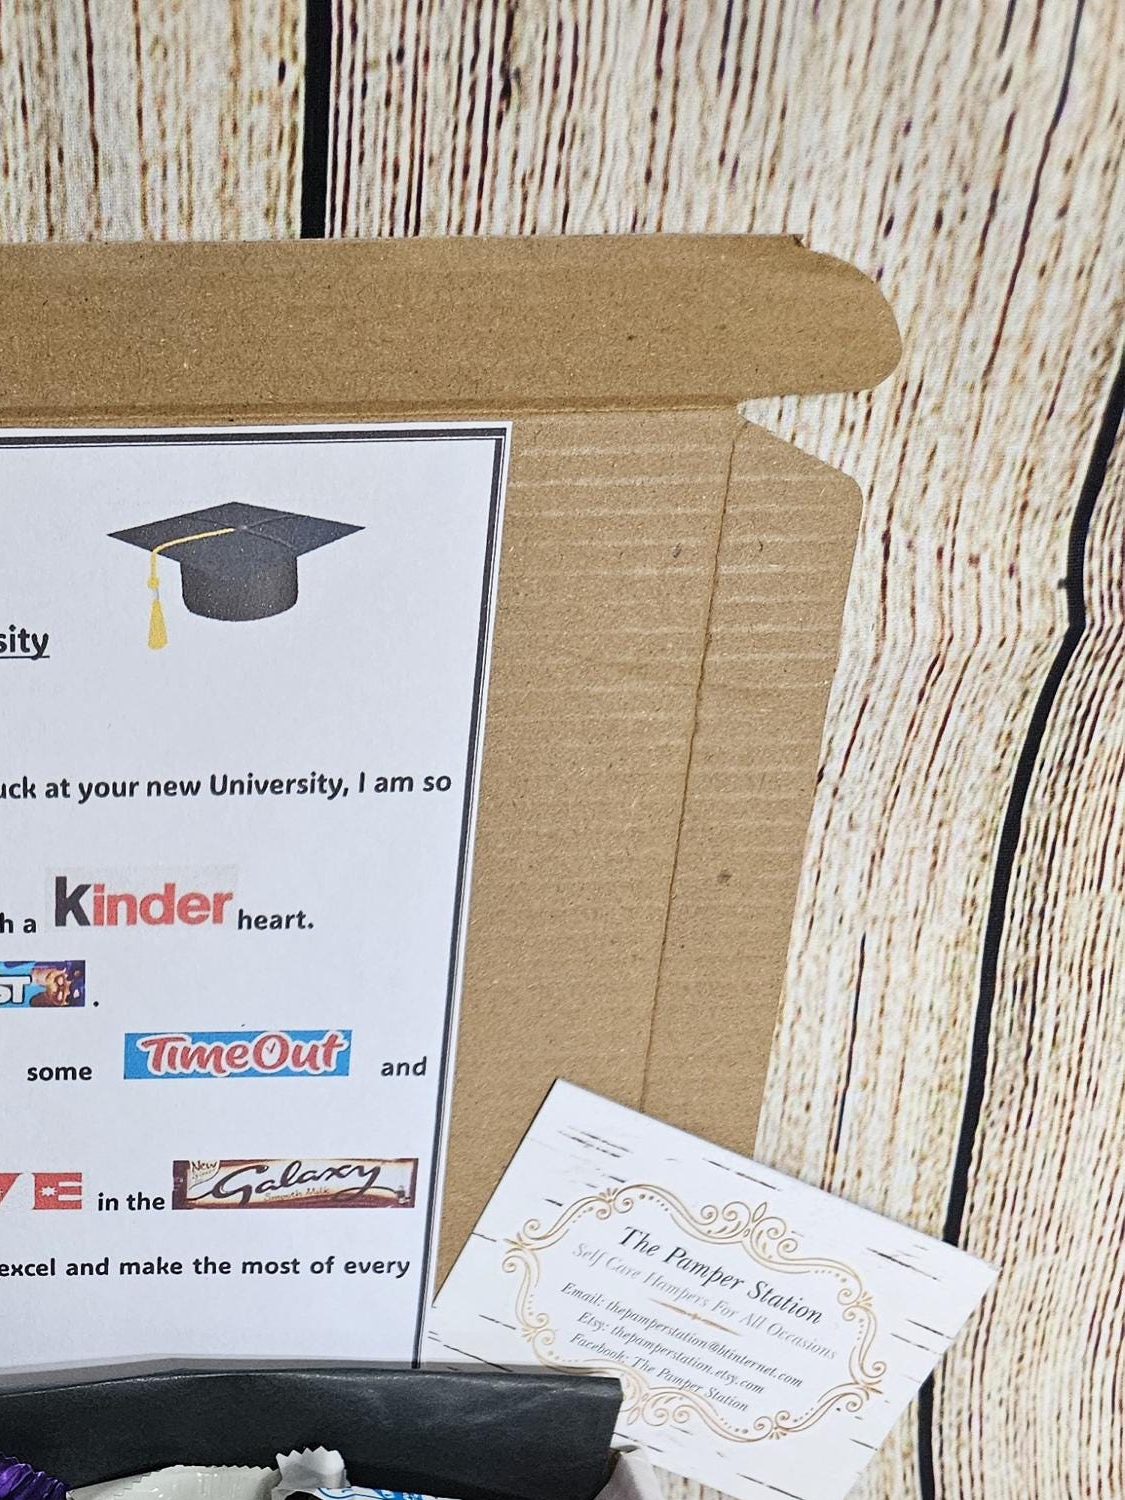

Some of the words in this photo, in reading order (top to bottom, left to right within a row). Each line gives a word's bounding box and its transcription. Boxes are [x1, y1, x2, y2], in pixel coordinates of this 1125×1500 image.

[45, 778, 71, 799] at
[77, 781, 140, 805] your
[146, 780, 202, 797] new
[209, 771, 349, 801] University,
[358, 771, 366, 793] I
[374, 776, 414, 793] am
[422, 775, 452, 792] so
[22, 918, 37, 934] a
[54, 876, 234, 927] Kinder
[237, 908, 314, 931] heart.
[26, 1066, 93, 1082] some
[380, 1055, 427, 1077] and
[98, 1192, 119, 1212] in
[125, 1191, 165, 1211] the
[200, 1160, 385, 1207] Galaxy
[65, 1256, 110, 1277] and
[119, 1256, 183, 1276] make
[192, 1255, 232, 1275] the
[241, 1258, 301, 1275] most
[310, 1255, 336, 1275] of
[343, 1260, 411, 1279] every
[618, 1225, 657, 1257] The
[663, 1246, 744, 1291] Pamper
[747, 1280, 824, 1324] Station
[560, 1282, 604, 1308] Email:
[606, 1299, 804, 1388] thepamperstation@btinternet.com
[572, 1243, 603, 1268] Self
[606, 1254, 641, 1280] Care
[642, 1271, 708, 1308] Hampers
[711, 1299, 740, 1319] For
[740, 1311, 764, 1331] All
[768, 1322, 838, 1360] Occasions
[570, 1333, 629, 1363] Facebook:
[631, 1356, 655, 1375] The
[657, 1367, 707, 1393] Pamper
[707, 1380, 749, 1412] Station
[576, 1311, 610, 1334] Etsy:
[610, 1324, 766, 1395] thepamperstation.etsy.com
